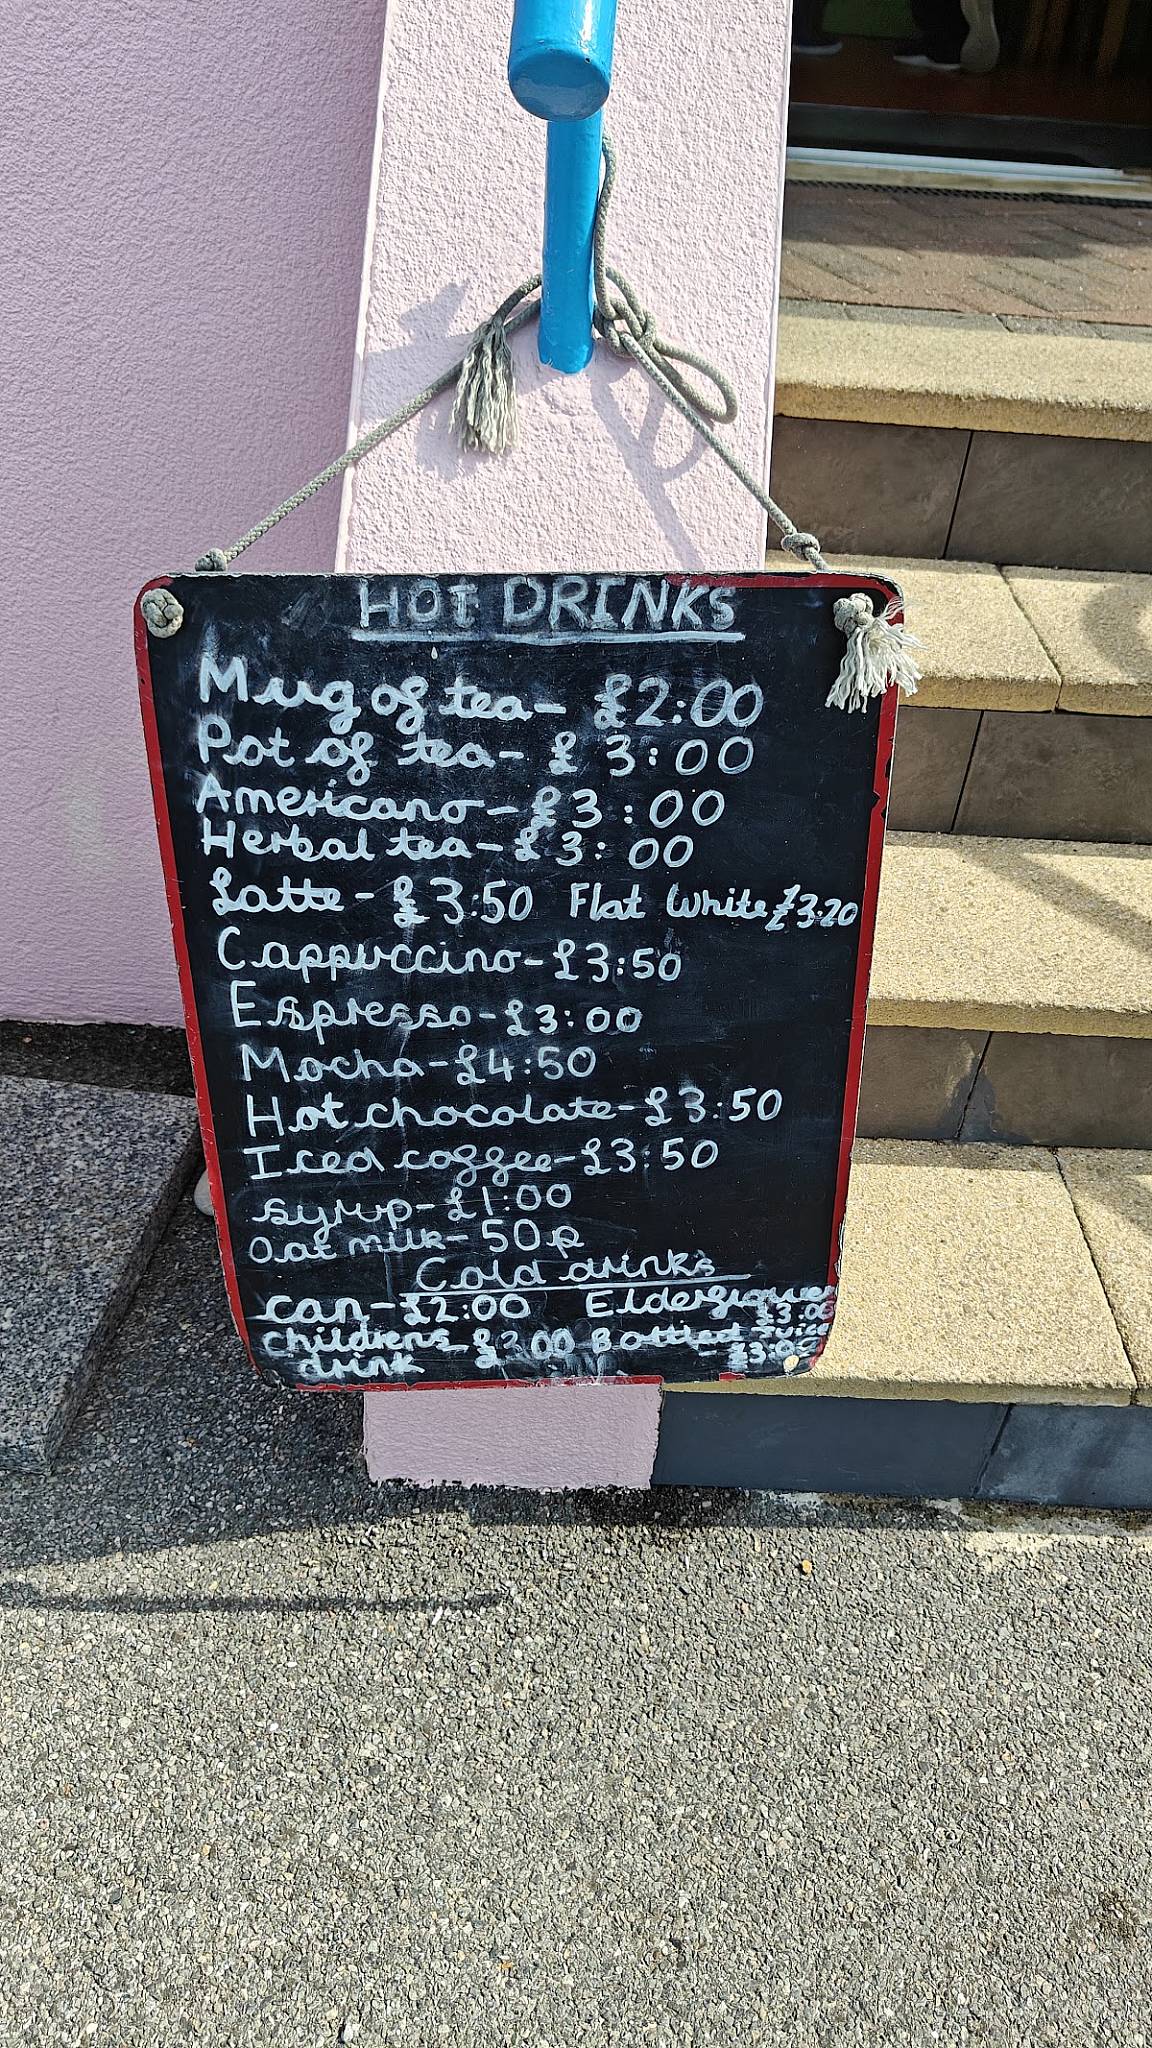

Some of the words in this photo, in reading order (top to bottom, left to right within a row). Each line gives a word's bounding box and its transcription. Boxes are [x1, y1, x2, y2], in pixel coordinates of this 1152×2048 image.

[359, 578, 479, 629] HOT
[502, 577, 736, 631] DRINKS
[200, 656, 362, 734] Mug
[371, 676, 429, 736] of
[197, 714, 295, 767] Pot
[305, 731, 378, 786] of
[202, 823, 375, 863] Herbal
[210, 866, 344, 916] Latte
[569, 882, 646, 922] Flat
[666, 882, 768, 919] White
[247, 1093, 349, 1138] Hot
[243, 1143, 385, 1181] Iced
[249, 1236, 334, 1265] Oat
[415, 1255, 546, 1292] Cold
[559, 1249, 716, 1281] drinks
[590, 1321, 743, 1354] Bottled
[299, 1351, 426, 1379] drink
